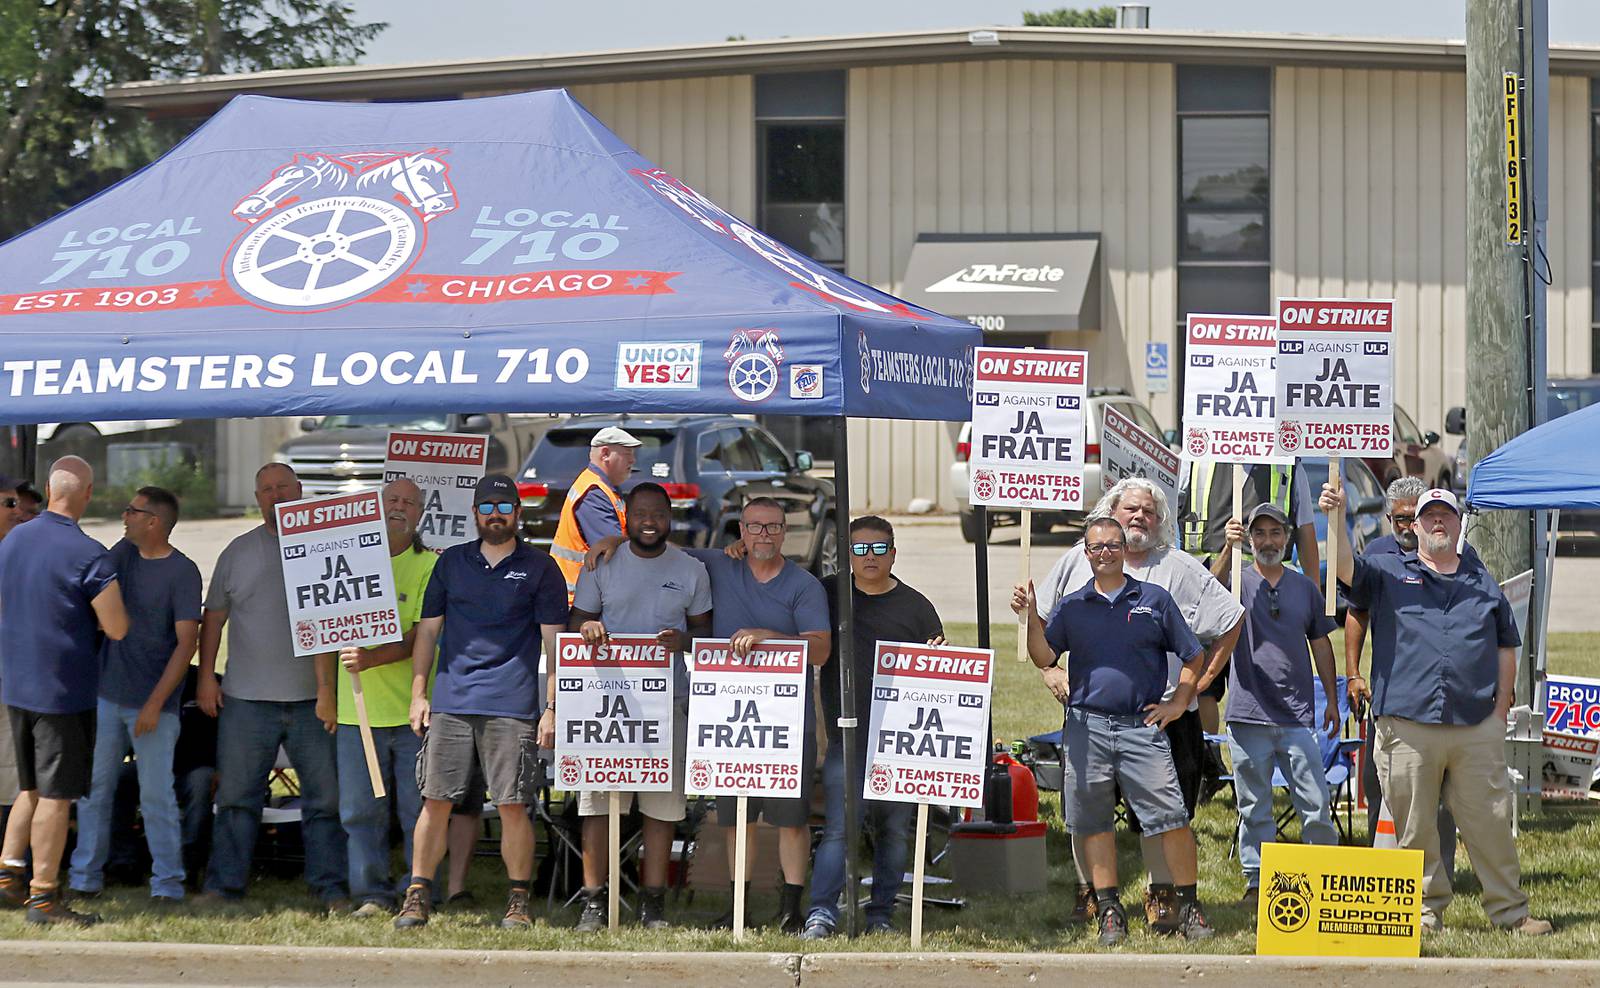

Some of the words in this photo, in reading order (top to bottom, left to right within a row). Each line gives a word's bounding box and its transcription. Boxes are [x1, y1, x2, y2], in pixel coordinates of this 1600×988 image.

[1505, 77, 1519, 240] DF116132
[475, 206, 629, 230] LOCAL
[59, 217, 202, 247] LOCAL
[238, 213, 292, 274] International
[296, 198, 390, 215] Brotherhood
[378, 221, 410, 273] Teamsters
[460, 229, 620, 265] 710
[40, 241, 190, 284] 710
[441, 274, 613, 297] CHICAGO
[13, 292, 83, 311] EST.
[94, 288, 179, 307] 1903
[1282, 307, 1315, 324] ON
[1317, 308, 1390, 326] STRIKE
[1192, 323, 1221, 340] ON
[625, 348, 695, 363] UNION
[1281, 342, 1302, 352] ULP
[1308, 343, 1360, 353] AGAINST
[1365, 343, 1387, 354] ULP
[871, 349, 920, 384] TEAMSTERS
[921, 355, 947, 387] LOCAL
[949, 358, 965, 388] 710
[979, 357, 1009, 375] ON
[1012, 359, 1081, 378] STRIKE
[1192, 356, 1213, 366] ULP
[1218, 357, 1266, 368] AGAINST
[1315, 358, 1351, 382] JA
[3, 353, 296, 397] TEAMSTERS
[310, 349, 478, 387] LOCAL
[495, 348, 590, 384] 710
[624, 364, 671, 384] YES
[1224, 371, 1258, 394] JA
[978, 393, 998, 405] ULP
[1003, 395, 1052, 407] AGAINST
[1058, 397, 1079, 408] ULP
[1286, 383, 1380, 408] FRATE
[1010, 410, 1044, 435] JA
[1306, 423, 1390, 436] TEAMSTERS
[1107, 414, 1128, 434] ON
[1129, 430, 1177, 470] STRIKE
[1212, 430, 1275, 443] TEAMSTE
[1304, 436, 1357, 450] LOCAL
[1361, 437, 1390, 451] 710
[390, 439, 418, 456] ON
[420, 441, 482, 459] STRIKE
[982, 434, 1072, 461] FRATE
[1211, 443, 1261, 457] LOCAL
[457, 478, 477, 487] ULP
[999, 472, 1081, 487] TEAMSTERS
[998, 486, 1048, 501] LOCAL
[1052, 489, 1080, 502] 710
[282, 509, 310, 529] ON
[313, 499, 376, 522] STRIKE
[418, 513, 467, 537] ATE
[309, 538, 355, 554] AGAINST
[360, 534, 381, 546] ULP
[285, 546, 305, 559] ULP
[321, 554, 353, 581] JA
[296, 574, 383, 609] FRATE
[319, 609, 396, 631] TEAMSTERS
[321, 627, 369, 645] LOCAL
[372, 623, 397, 637] 710
[562, 644, 593, 661] ON
[596, 645, 666, 661] STRIKE
[697, 649, 726, 666] ON
[731, 650, 800, 667] STRIKE
[880, 652, 912, 670] ON
[915, 655, 987, 676] STRIKE
[560, 680, 582, 690] ULP
[587, 680, 638, 690] AGAINST
[643, 680, 665, 690] ULP
[694, 684, 715, 694] ULP
[720, 685, 770, 695] AGAINST
[776, 686, 797, 696] ULP
[876, 688, 897, 699] ULP
[1549, 685, 1600, 703] PROU
[594, 695, 630, 718] JA
[903, 691, 954, 704] AGAINST
[960, 694, 982, 706] ULP
[726, 700, 761, 723] JA
[908, 707, 944, 732] JA
[1547, 700, 1600, 730] 710
[566, 720, 659, 743] FRATE
[697, 724, 789, 749] FRATE
[878, 730, 973, 760] FRATE
[1545, 735, 1594, 751] TRIKE
[586, 757, 669, 769] TEAMSTERS
[716, 762, 798, 775] TEAMSTERS
[585, 771, 636, 784] LOCAL
[640, 772, 669, 784] 710
[715, 776, 766, 789] LOCAL
[770, 777, 798, 790] 710
[897, 767, 981, 785] TEAMSTERS
[894, 782, 947, 798] LOCAL
[950, 786, 979, 800] 710
[1321, 874, 1415, 894] TEAMSTERS
[1320, 893, 1375, 904] LOCAL
[1381, 896, 1414, 906] 710
[1319, 908, 1414, 923] SUPPORT
[1321, 922, 1364, 934] MEMBERS
[1366, 924, 1380, 934] ON
[1381, 925, 1411, 936] STRIKE
